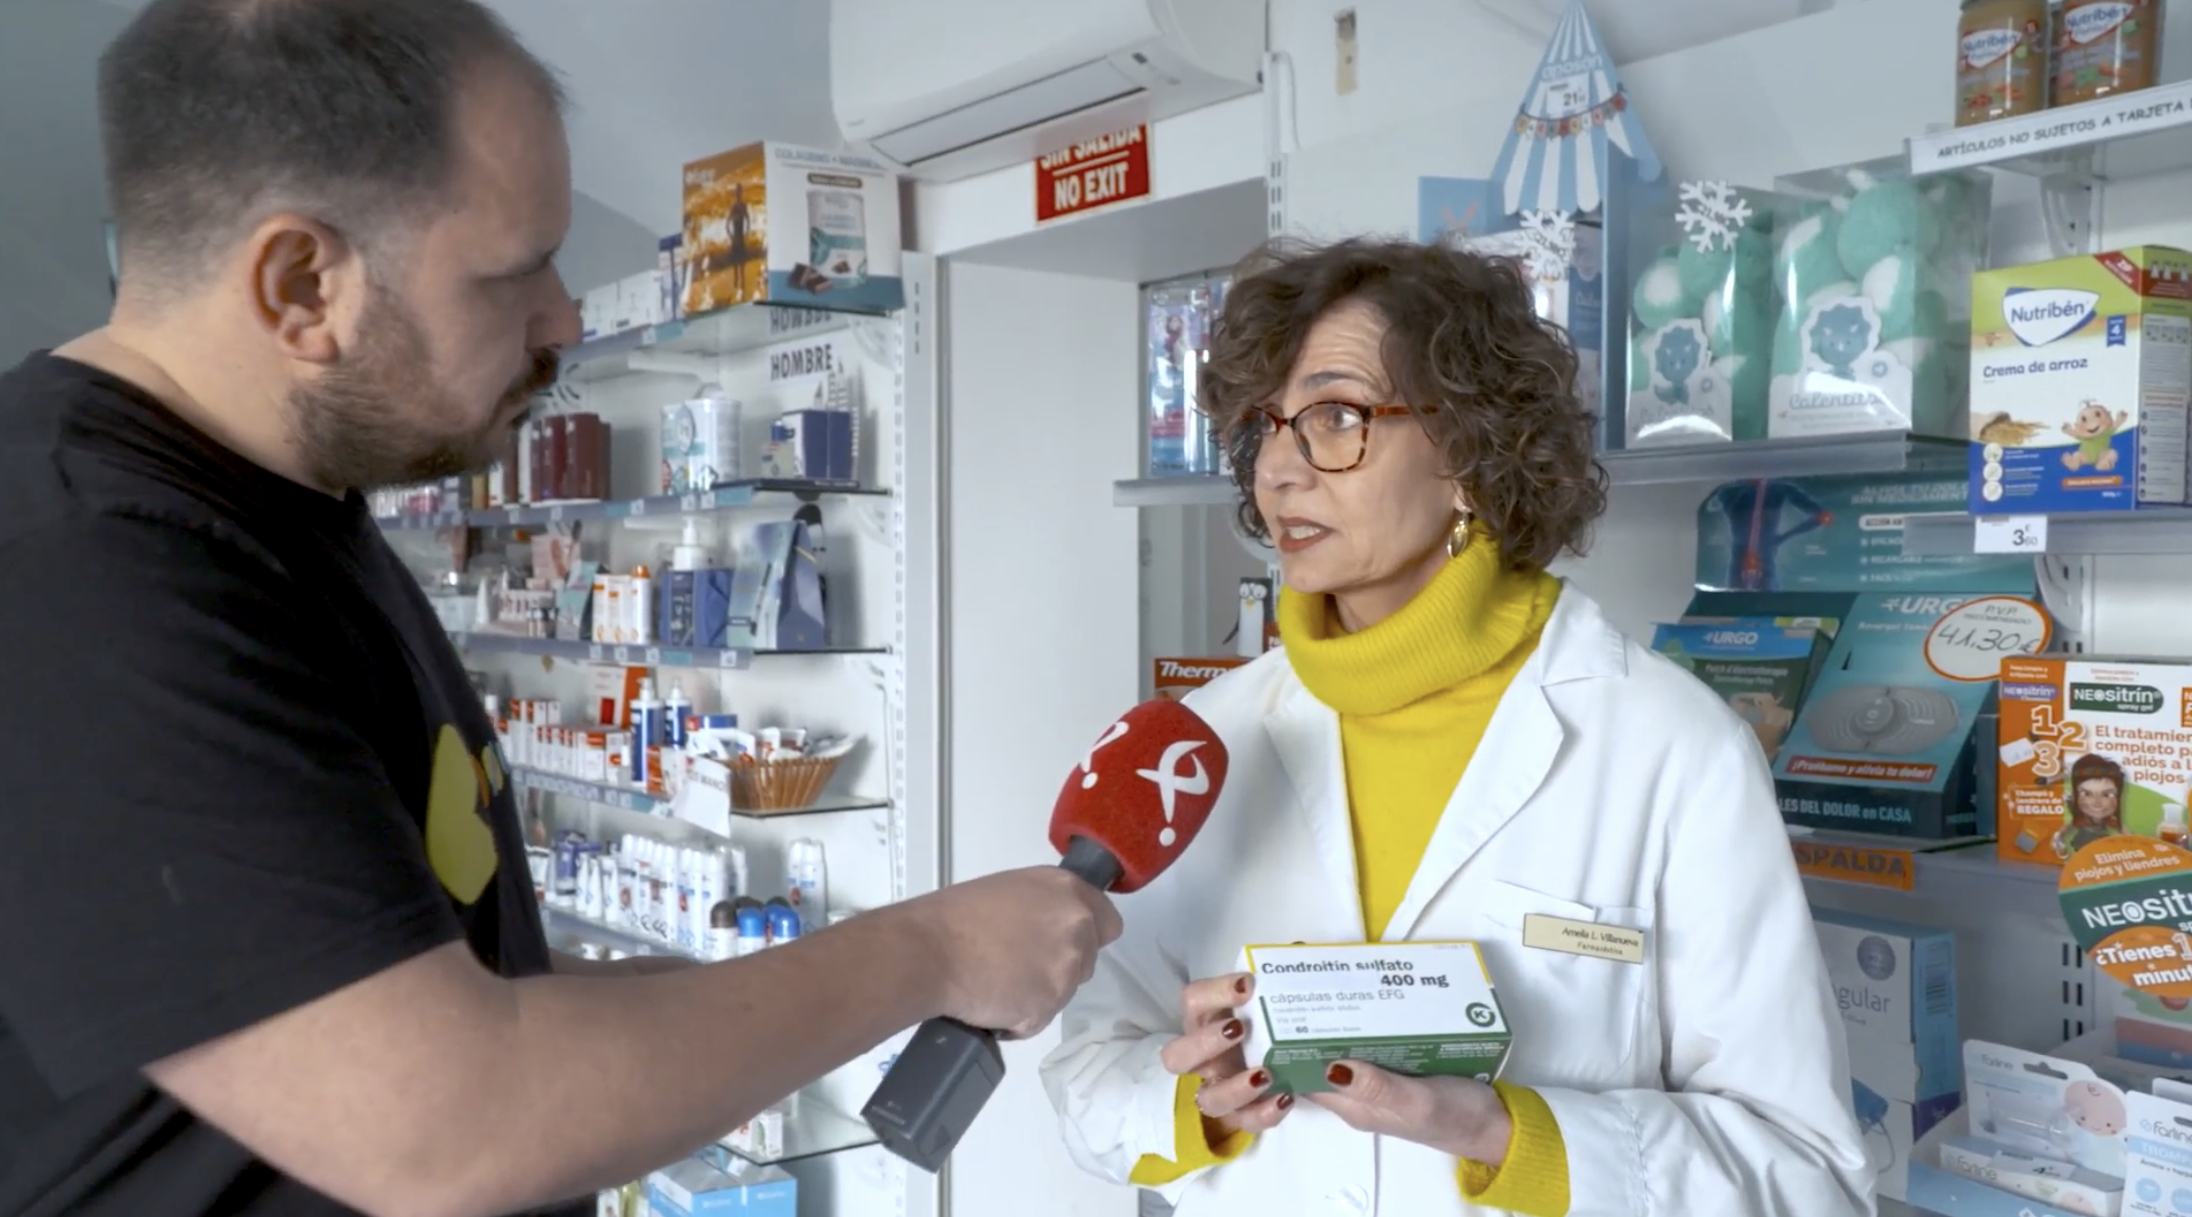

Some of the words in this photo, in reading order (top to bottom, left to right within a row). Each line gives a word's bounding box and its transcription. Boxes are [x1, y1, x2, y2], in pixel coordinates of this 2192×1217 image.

[1937, 138, 2006, 159] ARTÍCULOS
[2009, 131, 2030, 147] NO
[2034, 120, 2097, 141] SUJETOS
[2101, 115, 2111, 128] A
[2116, 102, 2185, 124] TARJETA
[1054, 174, 1081, 211] NO
[1084, 161, 1129, 203] EXIT
[2010, 301, 2085, 323] Nutribén
[2110, 324, 2121, 336] 4
[770, 343, 832, 382] HOMBRE
[1983, 363, 2025, 379] Crema
[2028, 360, 2045, 374] de
[2049, 358, 2088, 372] arroz
[2012, 529, 2026, 546] 3
[2024, 536, 2039, 546] 60
[1901, 597, 1963, 615] URG
[1713, 631, 1759, 645] URGO
[1159, 661, 1227, 679] Therm
[2031, 704, 2058, 736] 1
[2057, 720, 2087, 751] 2
[2095, 725, 2110, 738] El
[2113, 726, 2192, 743] tratamien
[2095, 740, 2175, 757] completo
[2031, 740, 2061, 777] 3
[2122, 754, 2167, 770] adiós
[2171, 760, 2182, 770] a
[2133, 769, 2185, 785] piojos
[1779, 798, 1798, 812] LES
[1801, 799, 1820, 815] DEL
[1823, 801, 1860, 819] DOLOR
[1862, 807, 1877, 819] en
[1879, 806, 1912, 823] CASA
[2016, 804, 2064, 815] REGALO
[1796, 843, 1904, 875] SPALDA
[2094, 849, 2146, 865] Elimina
[2074, 864, 2114, 882] piojos
[2114, 864, 2124, 876] y
[2124, 855, 2180, 872] liendres
[2179, 920, 2192, 934] sp
[2095, 943, 2177, 966] ¿Tienes
[1380, 973, 1415, 987] 400
[1420, 975, 1450, 989] mg
[2133, 965, 2192, 987] minut
[1270, 989, 1333, 1005] cápsulas
[1336, 988, 1375, 1002] duras
[1378, 988, 1405, 1000] EFG
[1832, 983, 1891, 1013] gular
